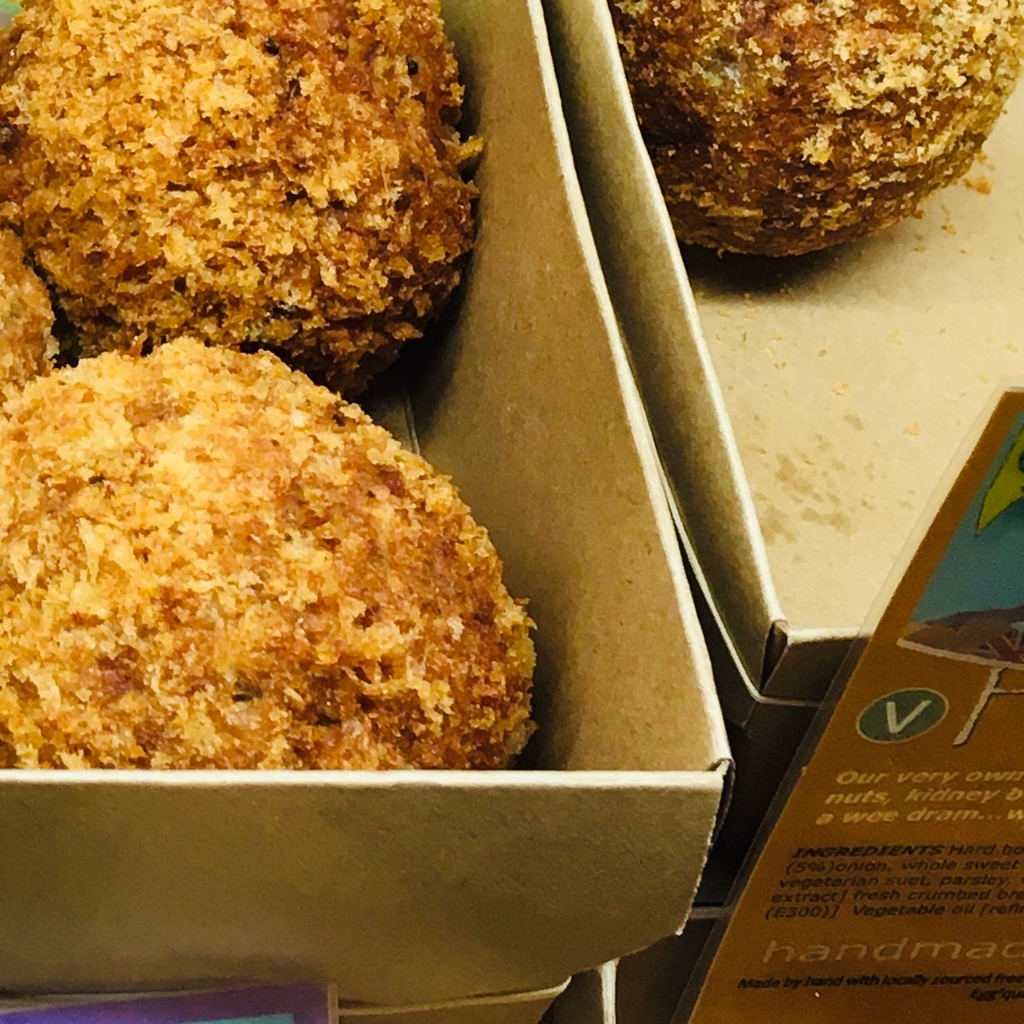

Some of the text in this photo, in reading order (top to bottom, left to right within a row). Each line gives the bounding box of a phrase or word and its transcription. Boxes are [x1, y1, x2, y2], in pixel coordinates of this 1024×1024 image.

[836, 770, 889, 785] Our
[897, 772, 958, 788] very
[824, 792, 891, 808] nuts,
[905, 788, 998, 804] kidney
